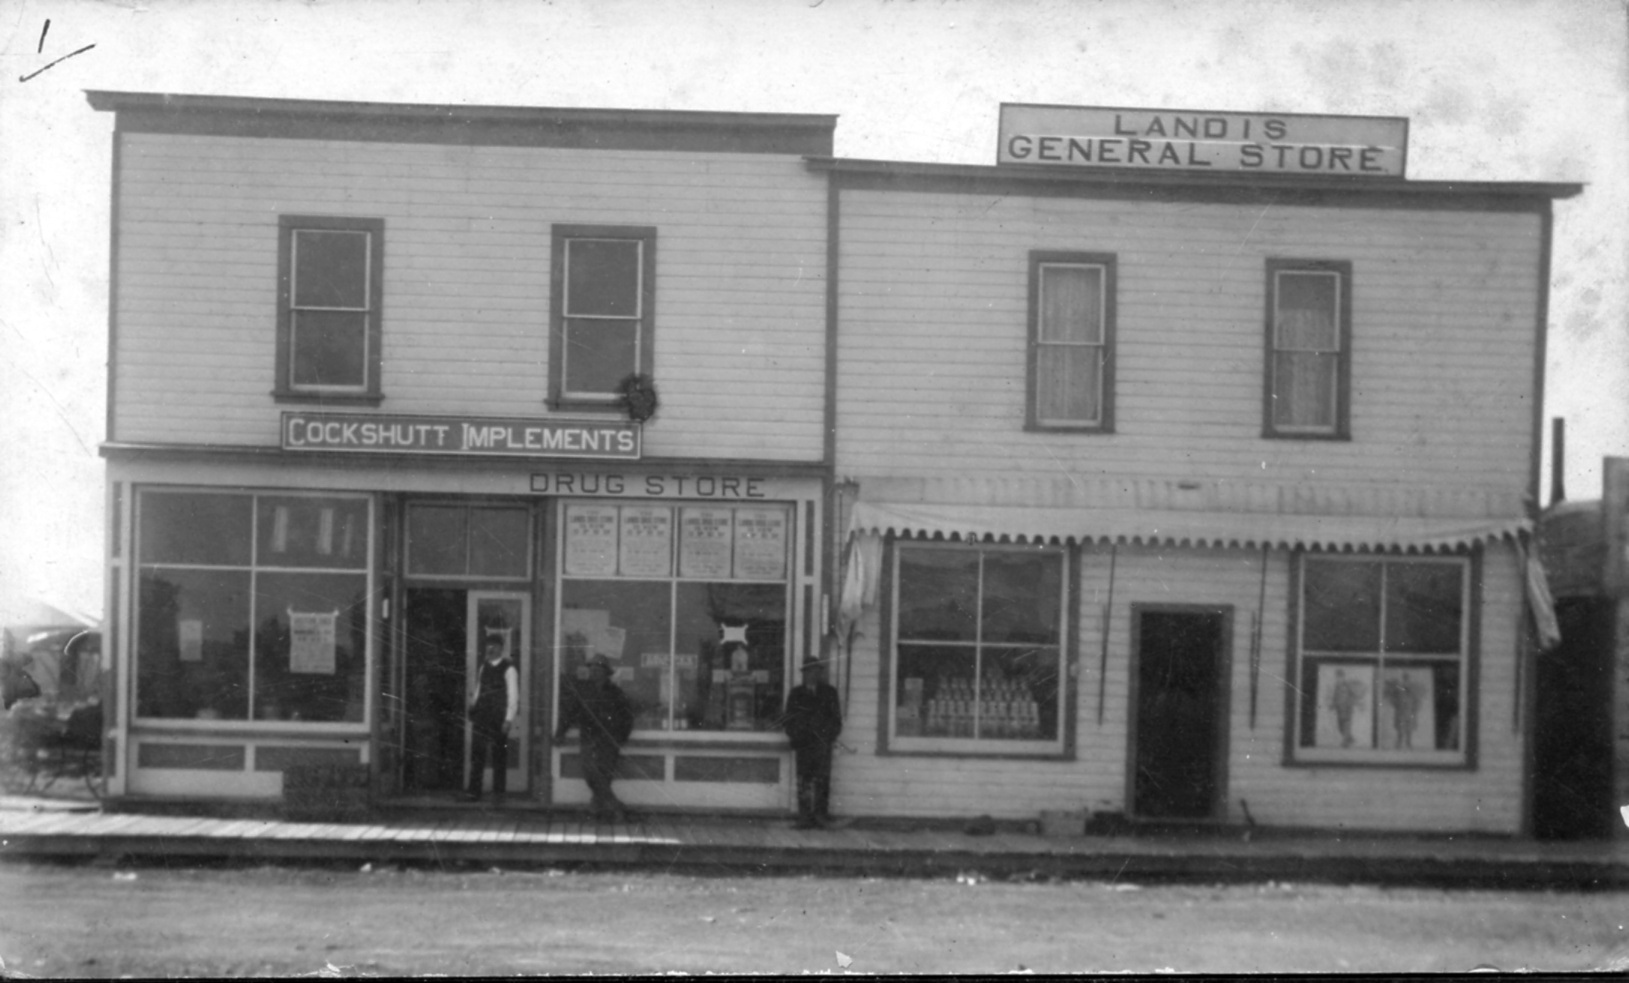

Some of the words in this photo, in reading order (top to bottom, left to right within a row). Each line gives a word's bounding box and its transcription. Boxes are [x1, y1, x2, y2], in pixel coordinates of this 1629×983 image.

[1115, 113, 1288, 140] LANDIS
[1007, 134, 1212, 167] GENERAL
[1239, 143, 1384, 172] STORE
[288, 417, 450, 447] COCKSHUTT
[460, 422, 635, 452] IMPLEMENTS
[529, 472, 625, 496] DRUG
[644, 475, 766, 498] STORE
